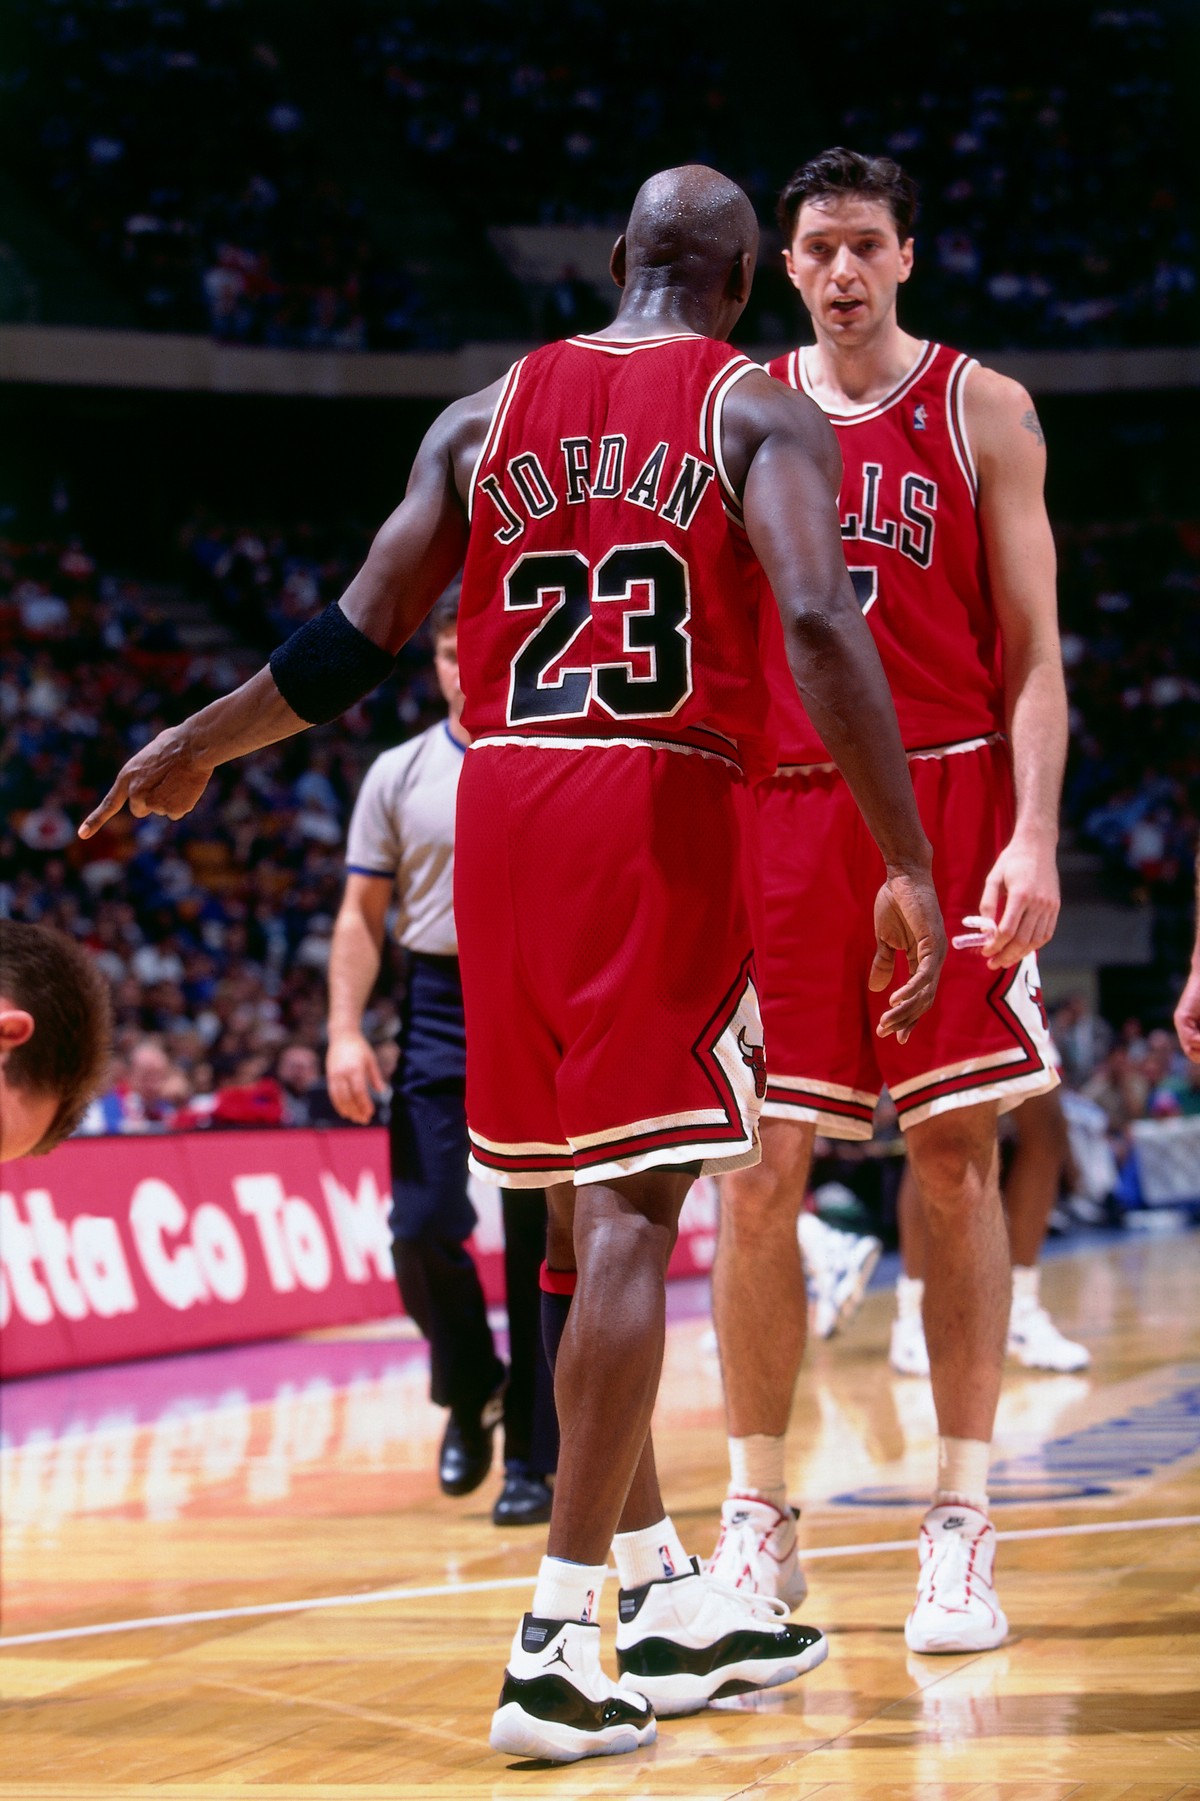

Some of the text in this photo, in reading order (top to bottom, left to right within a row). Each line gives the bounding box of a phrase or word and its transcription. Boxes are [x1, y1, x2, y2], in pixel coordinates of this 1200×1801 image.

[478, 433, 716, 545] JORDAN
[503, 540, 693, 727] 23
[0, 1187, 138, 1329] tta
[128, 1176, 248, 1311] Go
[232, 1172, 332, 1293] To
